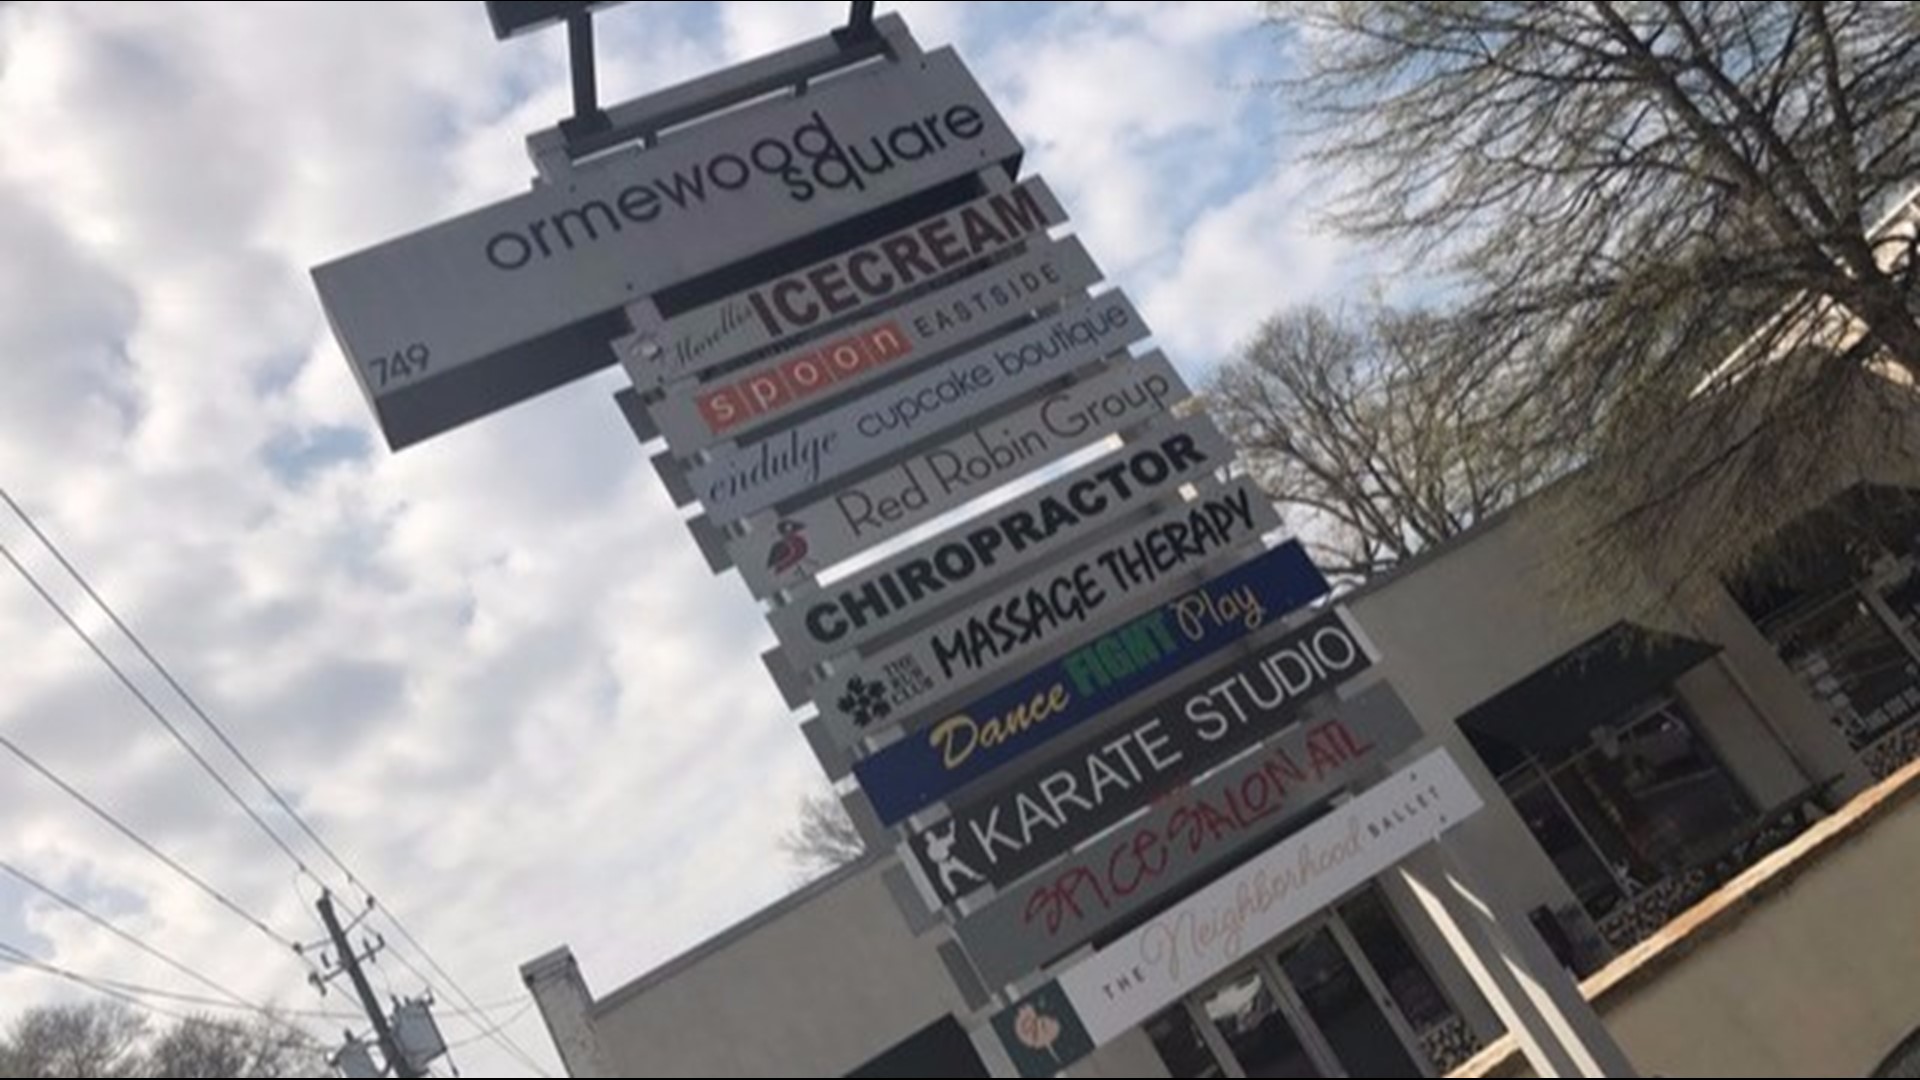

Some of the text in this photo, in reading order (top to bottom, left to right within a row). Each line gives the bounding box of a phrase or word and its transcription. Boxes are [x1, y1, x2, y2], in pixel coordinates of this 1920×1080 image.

[486, 111, 834, 272] ormewood
[780, 102, 985, 203] square
[711, 261, 1062, 422] spoon EASTSIDE
[747, 186, 1055, 338] ICECREAM
[368, 341, 430, 387] 749
[857, 361, 994, 442] cupcake
[999, 303, 1130, 376] boutique
[836, 373, 1170, 538] Red Robin Group
[805, 431, 1207, 645] CHIROPRACTOR
[930, 490, 1256, 679] MASSAGE THERAPY
[929, 584, 1266, 769] Dance FIGHT Play
[969, 624, 1358, 864] KARATE STUDIO
[1167, 748, 1308, 853] SALON
[1304, 719, 1375, 782] ATL
[1102, 785, 1442, 1000] THE Neighborhood BALLET
